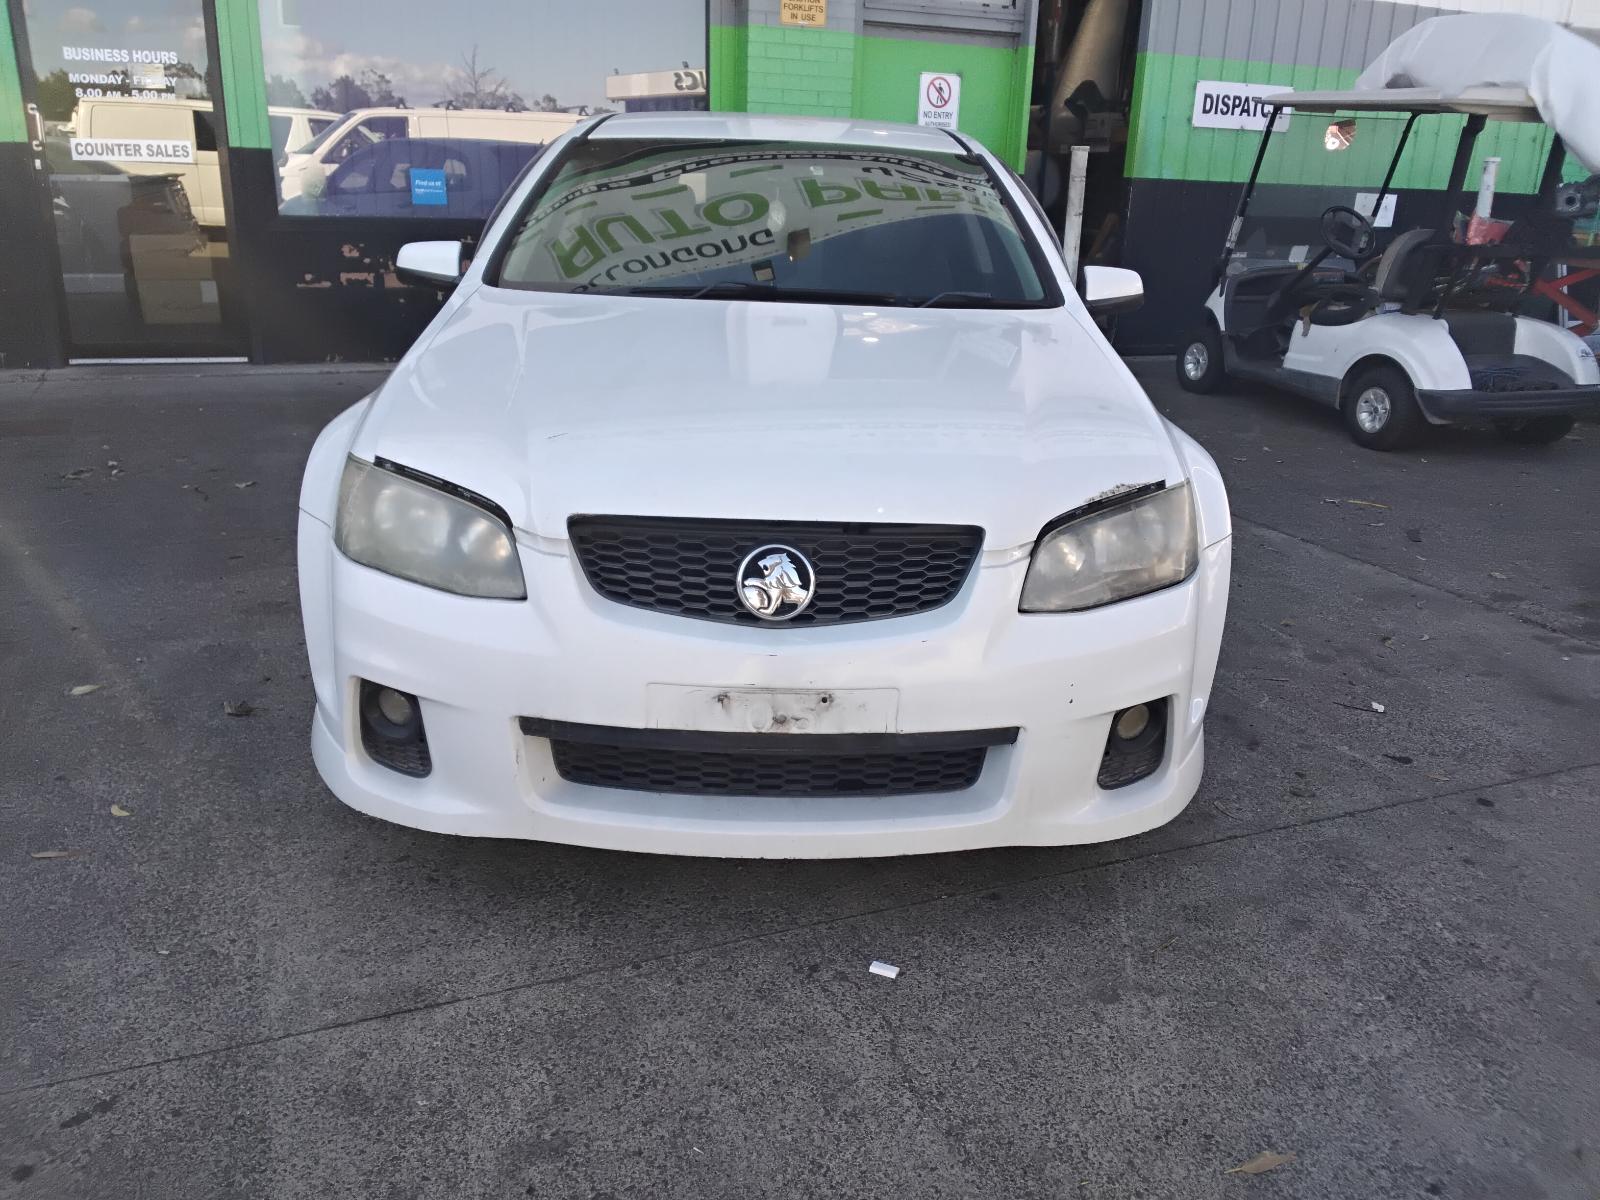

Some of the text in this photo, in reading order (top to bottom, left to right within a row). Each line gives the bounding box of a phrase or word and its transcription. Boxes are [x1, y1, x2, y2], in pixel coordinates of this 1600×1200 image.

[783, 2, 824, 14] FORKLIFTS
[790, 12, 816, 21] IN USE
[62, 46, 178, 65] BUSINESS HOURS
[68, 73, 124, 84] MONDAY
[75, 87, 103, 99] 8.00
[106, 90, 121, 99] AM
[131, 89, 158, 100] 5.00
[1202, 93, 1282, 119] DISPATC
[923, 110, 954, 120] NO ENTRY
[74, 142, 190, 159] COUNTER SALES
